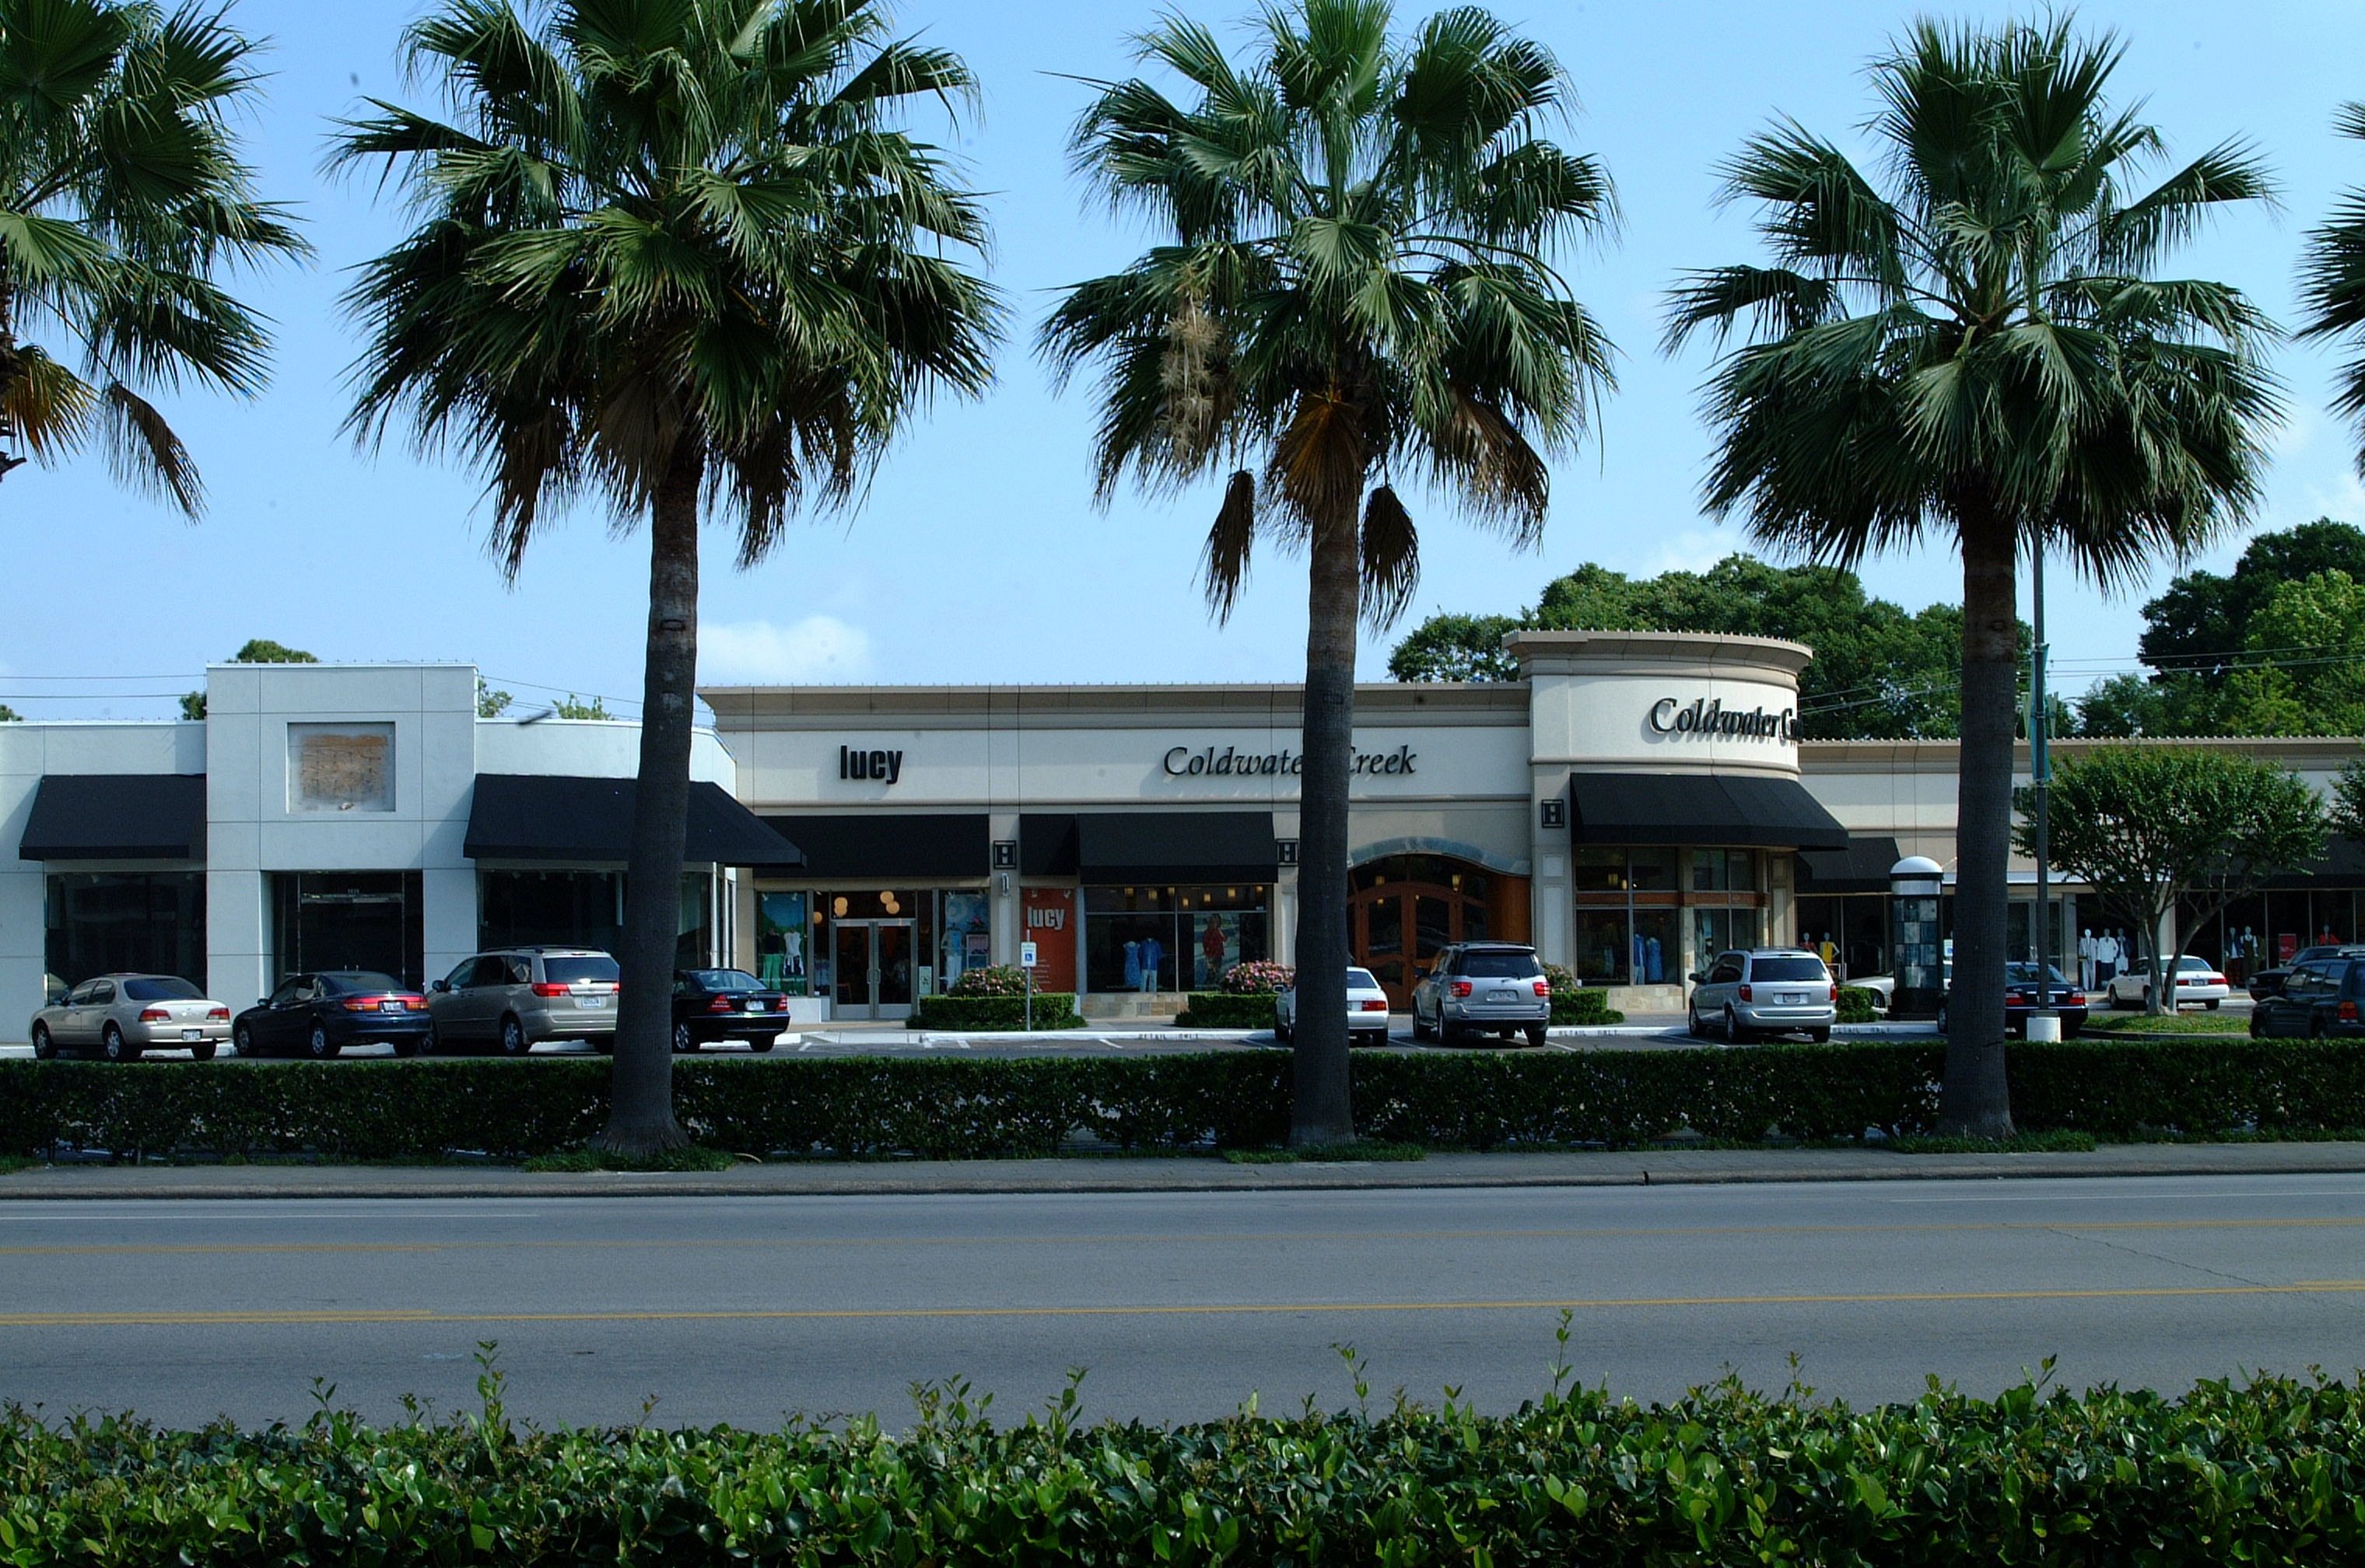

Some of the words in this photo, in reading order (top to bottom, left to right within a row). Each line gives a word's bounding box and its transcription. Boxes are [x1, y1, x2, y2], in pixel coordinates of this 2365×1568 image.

[1651, 698, 1780, 737] Coldwater
[840, 745, 902, 784] lucy
[1163, 746, 1304, 775] Coldwate
[1027, 905, 1065, 930] lucy
